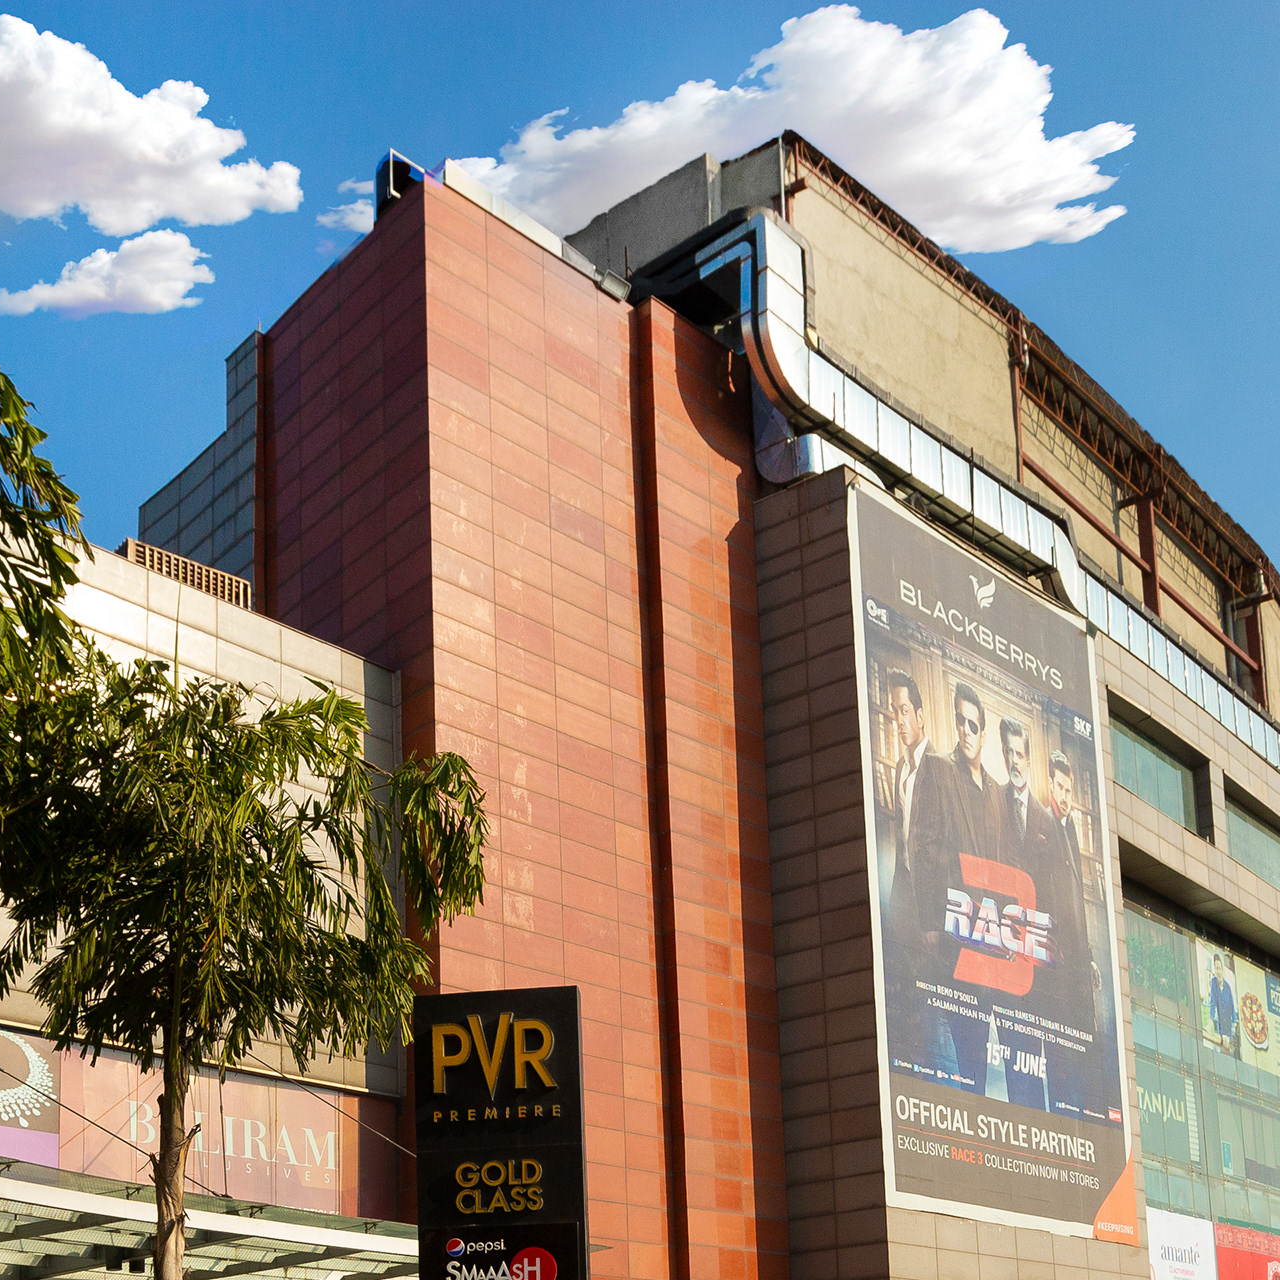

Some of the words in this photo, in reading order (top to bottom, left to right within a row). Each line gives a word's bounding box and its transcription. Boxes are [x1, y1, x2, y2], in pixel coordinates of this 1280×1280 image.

[900, 579, 1063, 690] BLACKBERRYS
[945, 888, 1053, 961] RACE
[954, 990, 978, 1006] D'SOUZA
[933, 998, 959, 1014] SALMAN
[960, 1006, 978, 1019] KHAN
[1002, 1019, 1014, 1030] TIPS
[1014, 1022, 1045, 1040] INDUSTRIES
[1046, 1033, 1056, 1043] LTD
[1015, 1009, 1036, 1023] RAMESH
[1065, 1026, 1080, 1038] SALMA
[1080, 1031, 1093, 1042] KHAN
[432, 1012, 559, 1101] PVR
[986, 1042, 1011, 1065] 15TH
[1013, 1051, 1048, 1079] JUNE
[434, 1104, 561, 1123] PREMIERE
[895, 1095, 974, 1135] OFFICIAL
[977, 1114, 1028, 1148] STYLE
[1031, 1127, 1095, 1163] PARTNER
[122, 1099, 339, 1169] BLIRAM
[455, 1158, 543, 1188] GOLD
[897, 1134, 950, 1159] EXCLUSIVE
[951, 1147, 976, 1164] RACE
[977, 1152, 983, 1166] 3
[984, 1153, 1039, 1177] COLLECTION
[1039, 1165, 1059, 1181] NOW
[1060, 1169, 1068, 1182] IN
[1069, 1172, 1100, 1190] STORES
[455, 1186, 544, 1214] CLASS
[1097, 1221, 1134, 1235] #KEEPRISING
[1160, 1242, 1200, 1266] amanté
